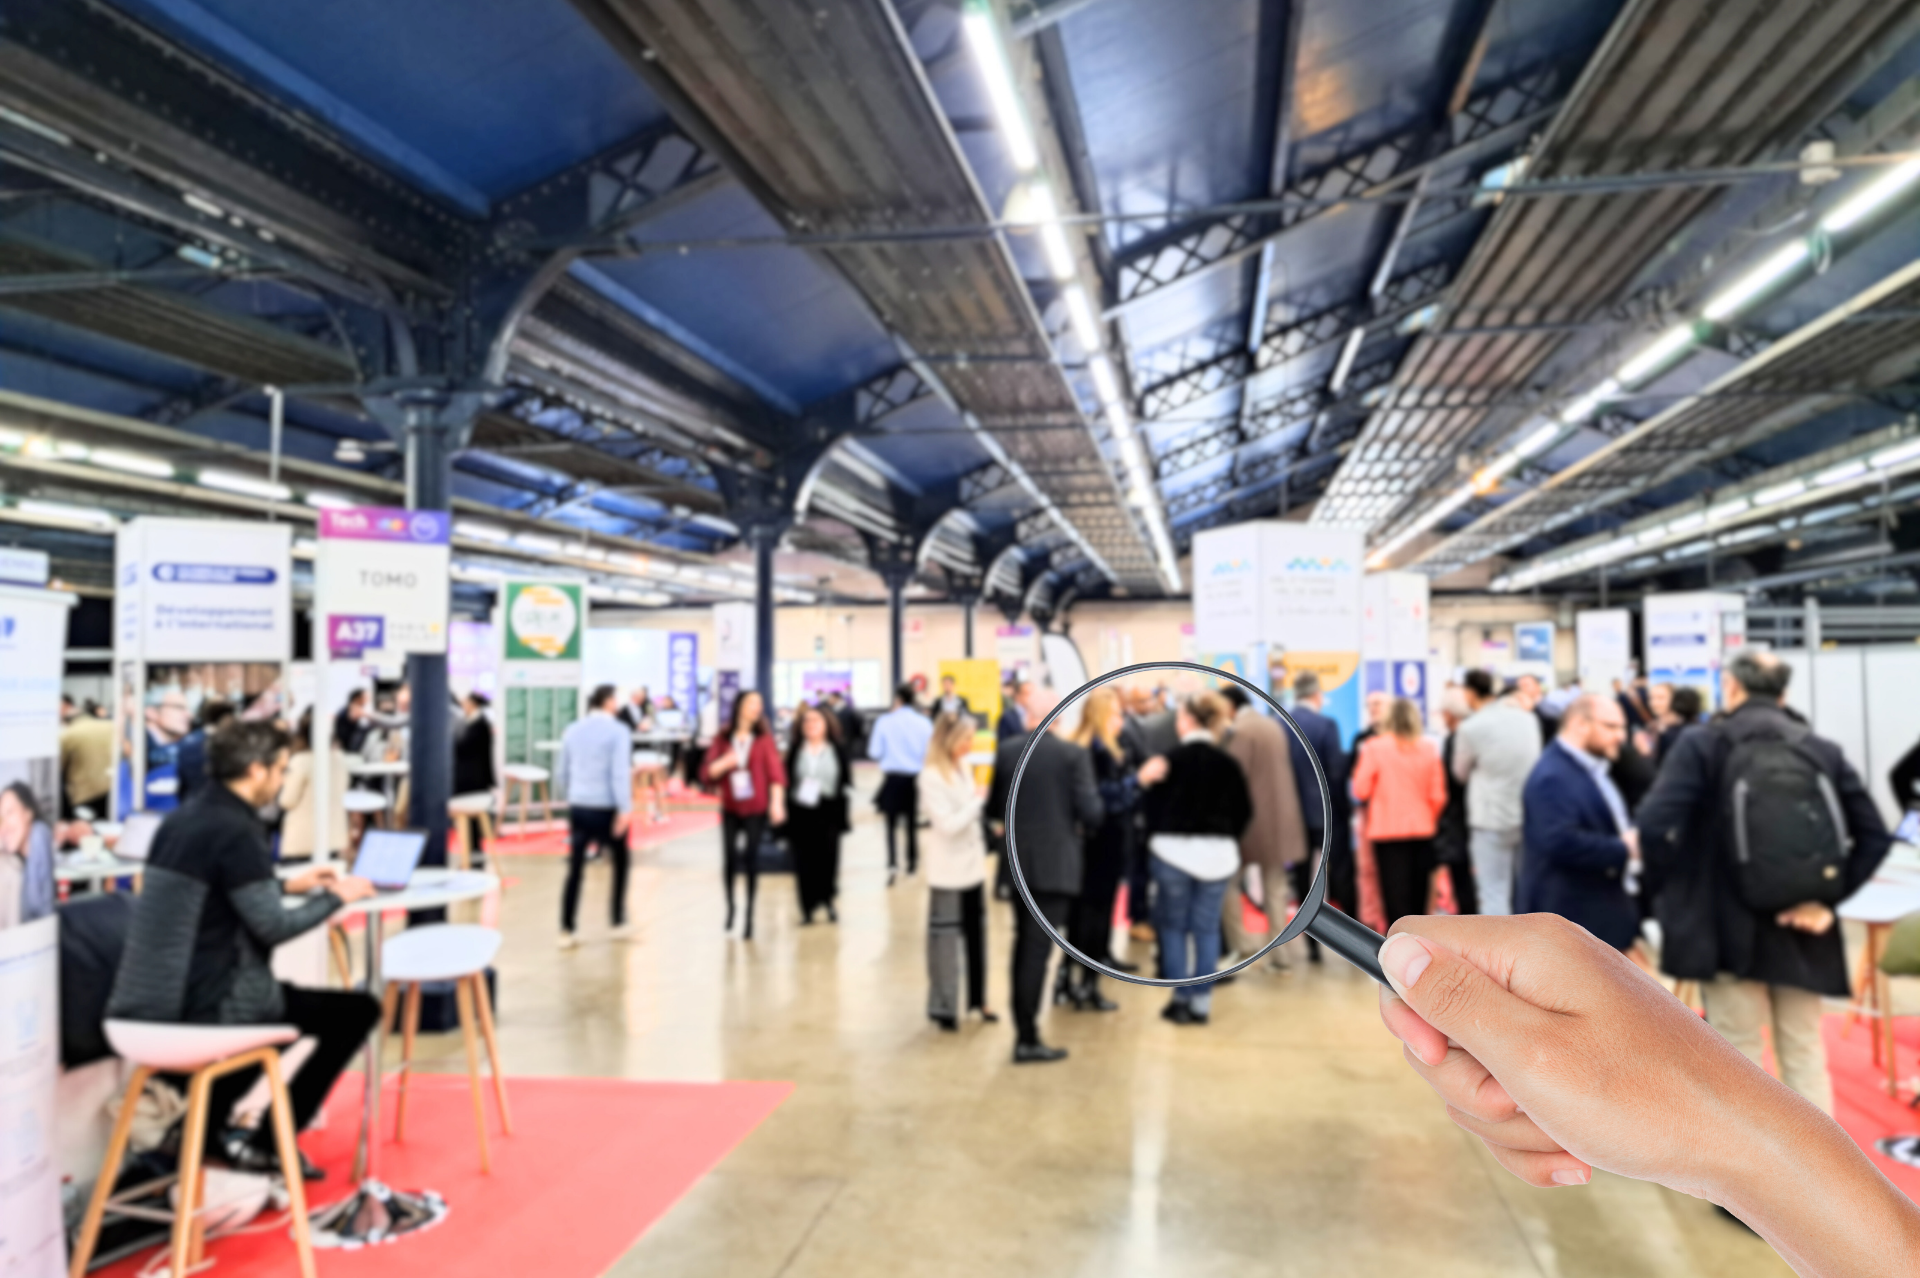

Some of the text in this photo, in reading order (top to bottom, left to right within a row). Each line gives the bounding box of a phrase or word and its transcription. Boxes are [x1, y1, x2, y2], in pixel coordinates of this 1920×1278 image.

[330, 512, 369, 530] Tech
[358, 570, 418, 589] TOMO
[155, 603, 273, 618] Développement
[335, 621, 380, 642] A37
